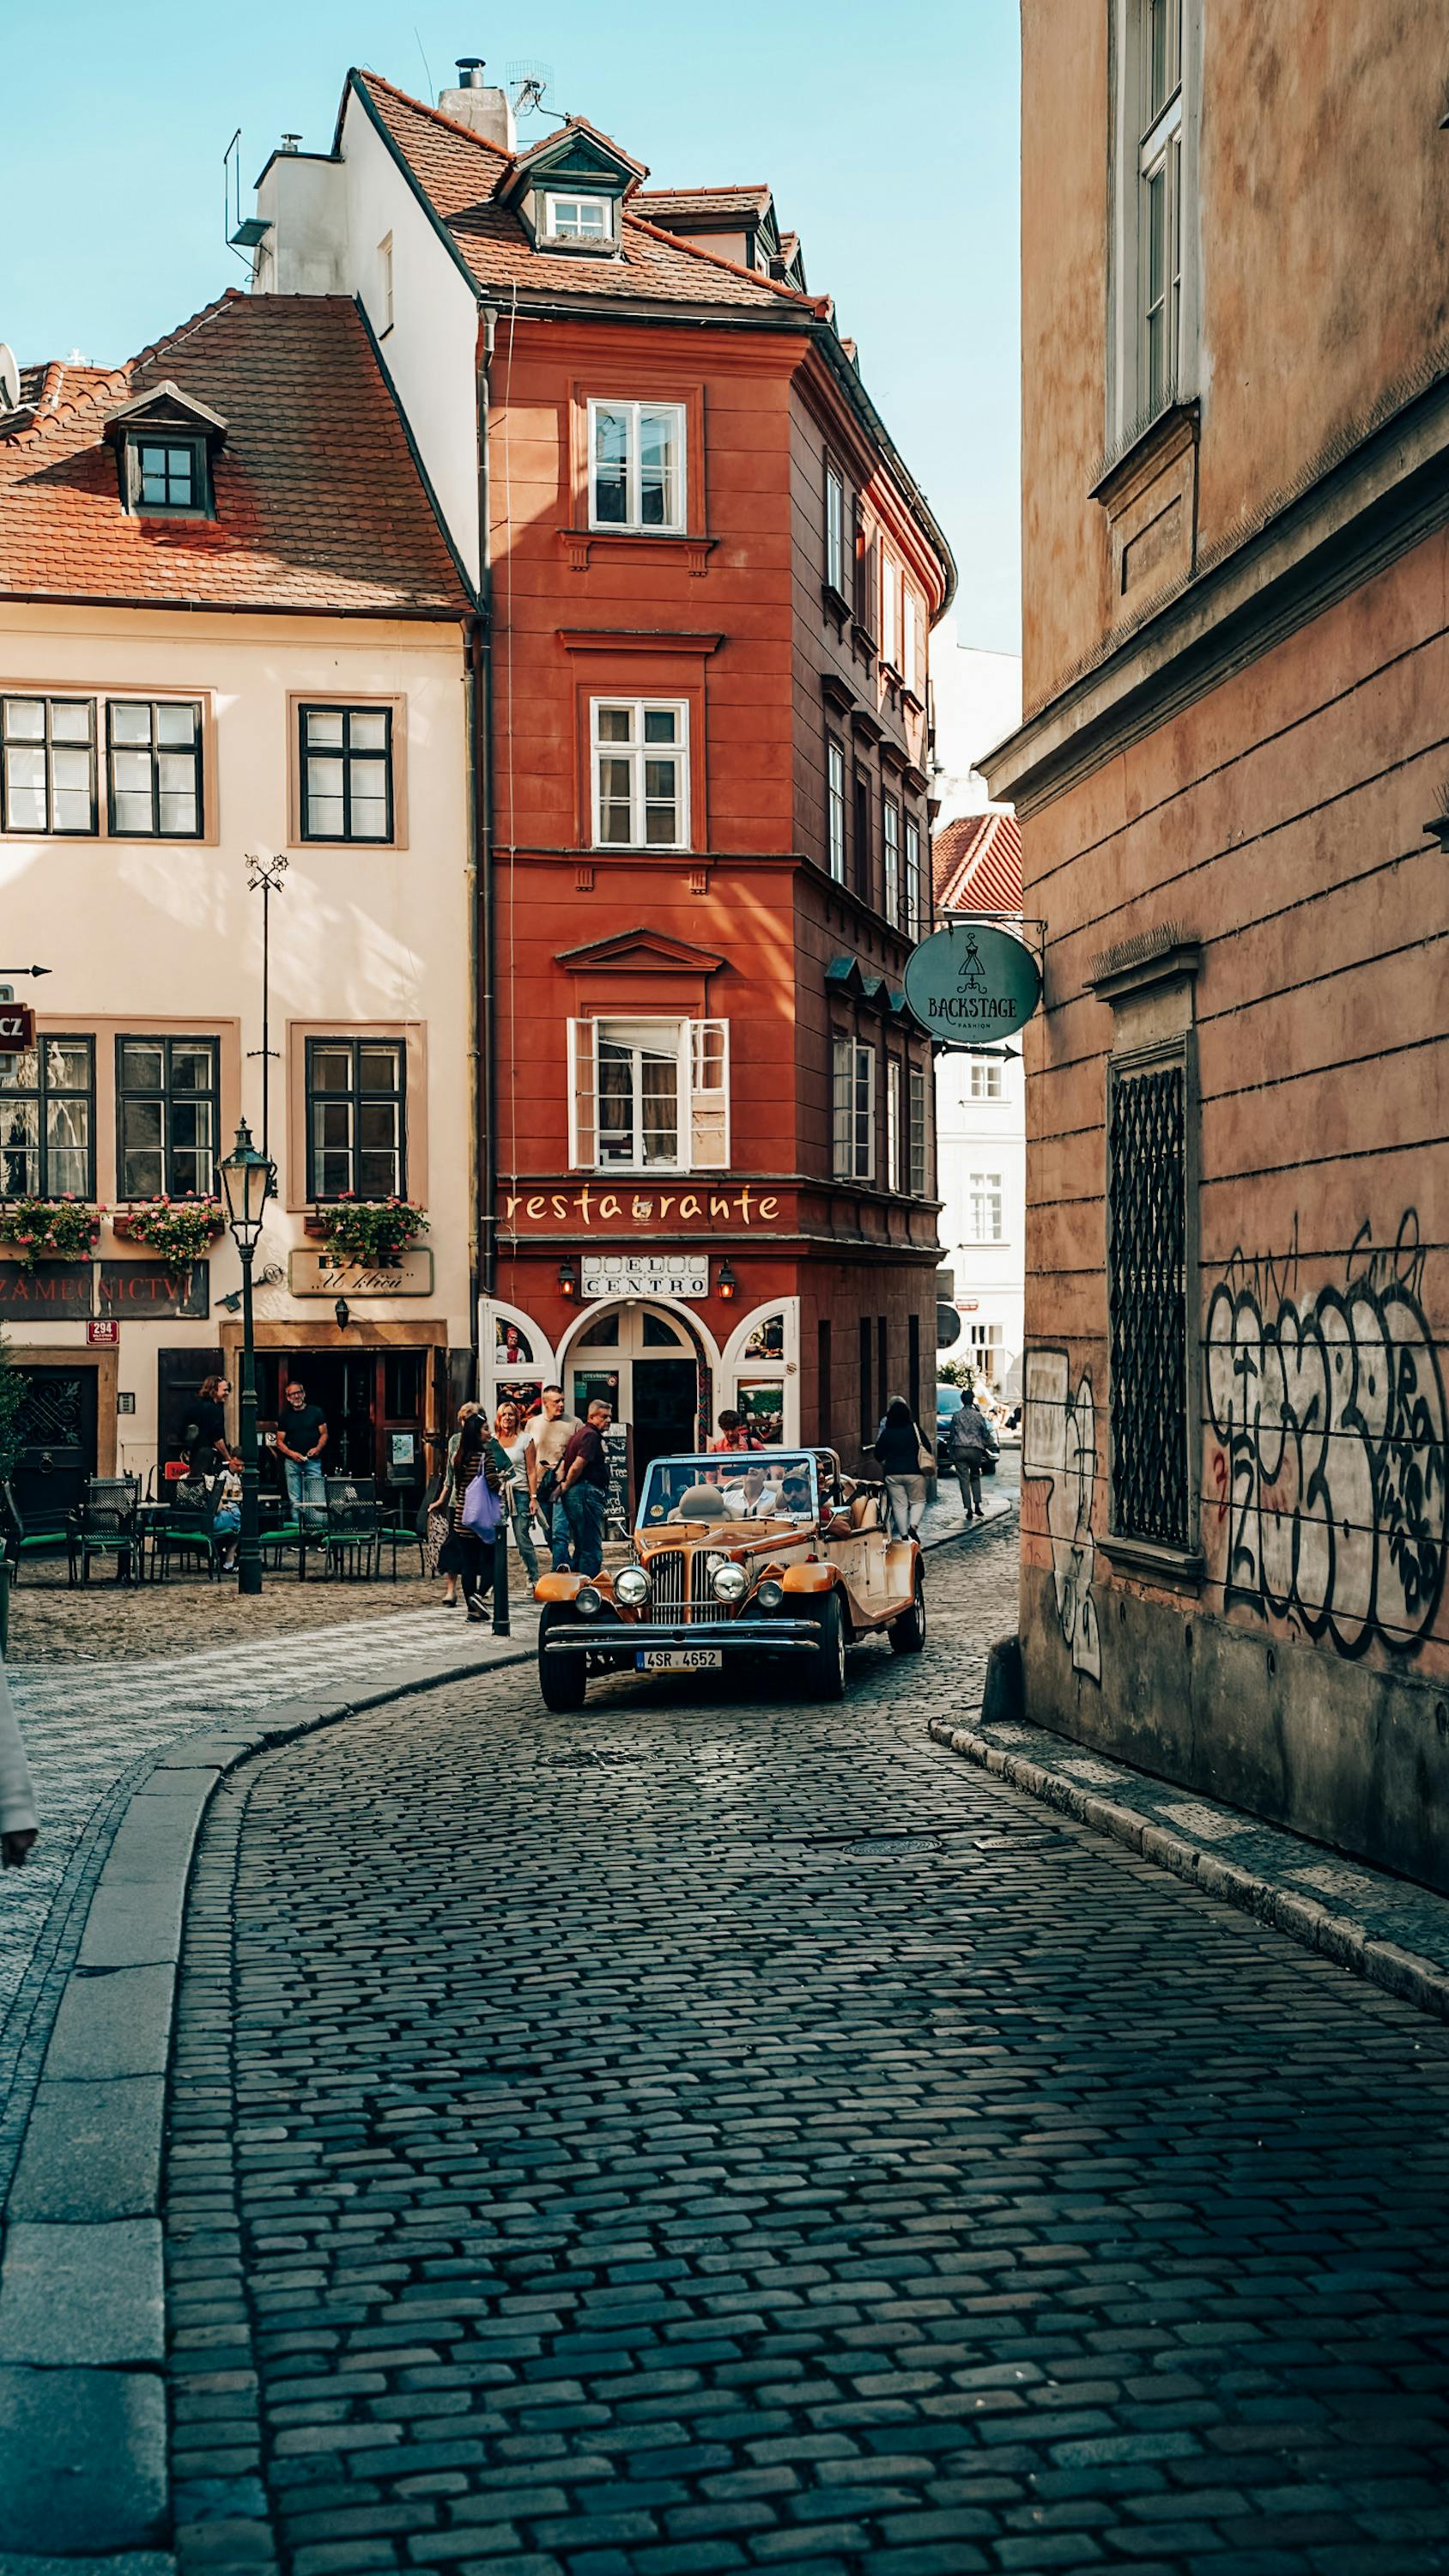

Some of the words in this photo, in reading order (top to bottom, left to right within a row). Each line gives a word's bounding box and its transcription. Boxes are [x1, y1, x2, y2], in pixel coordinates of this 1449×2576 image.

[928, 998, 1017, 1024] BACKSTAGE
[506, 1184, 779, 1225] restaurante
[318, 1255, 405, 1269] BAR
[628, 1259, 663, 1272] EL
[586, 1279, 704, 1292] CENTRO
[94, 1322, 112, 1334] 294
[647, 1653, 671, 1667] 4SR
[683, 1652, 716, 1666] 4652
